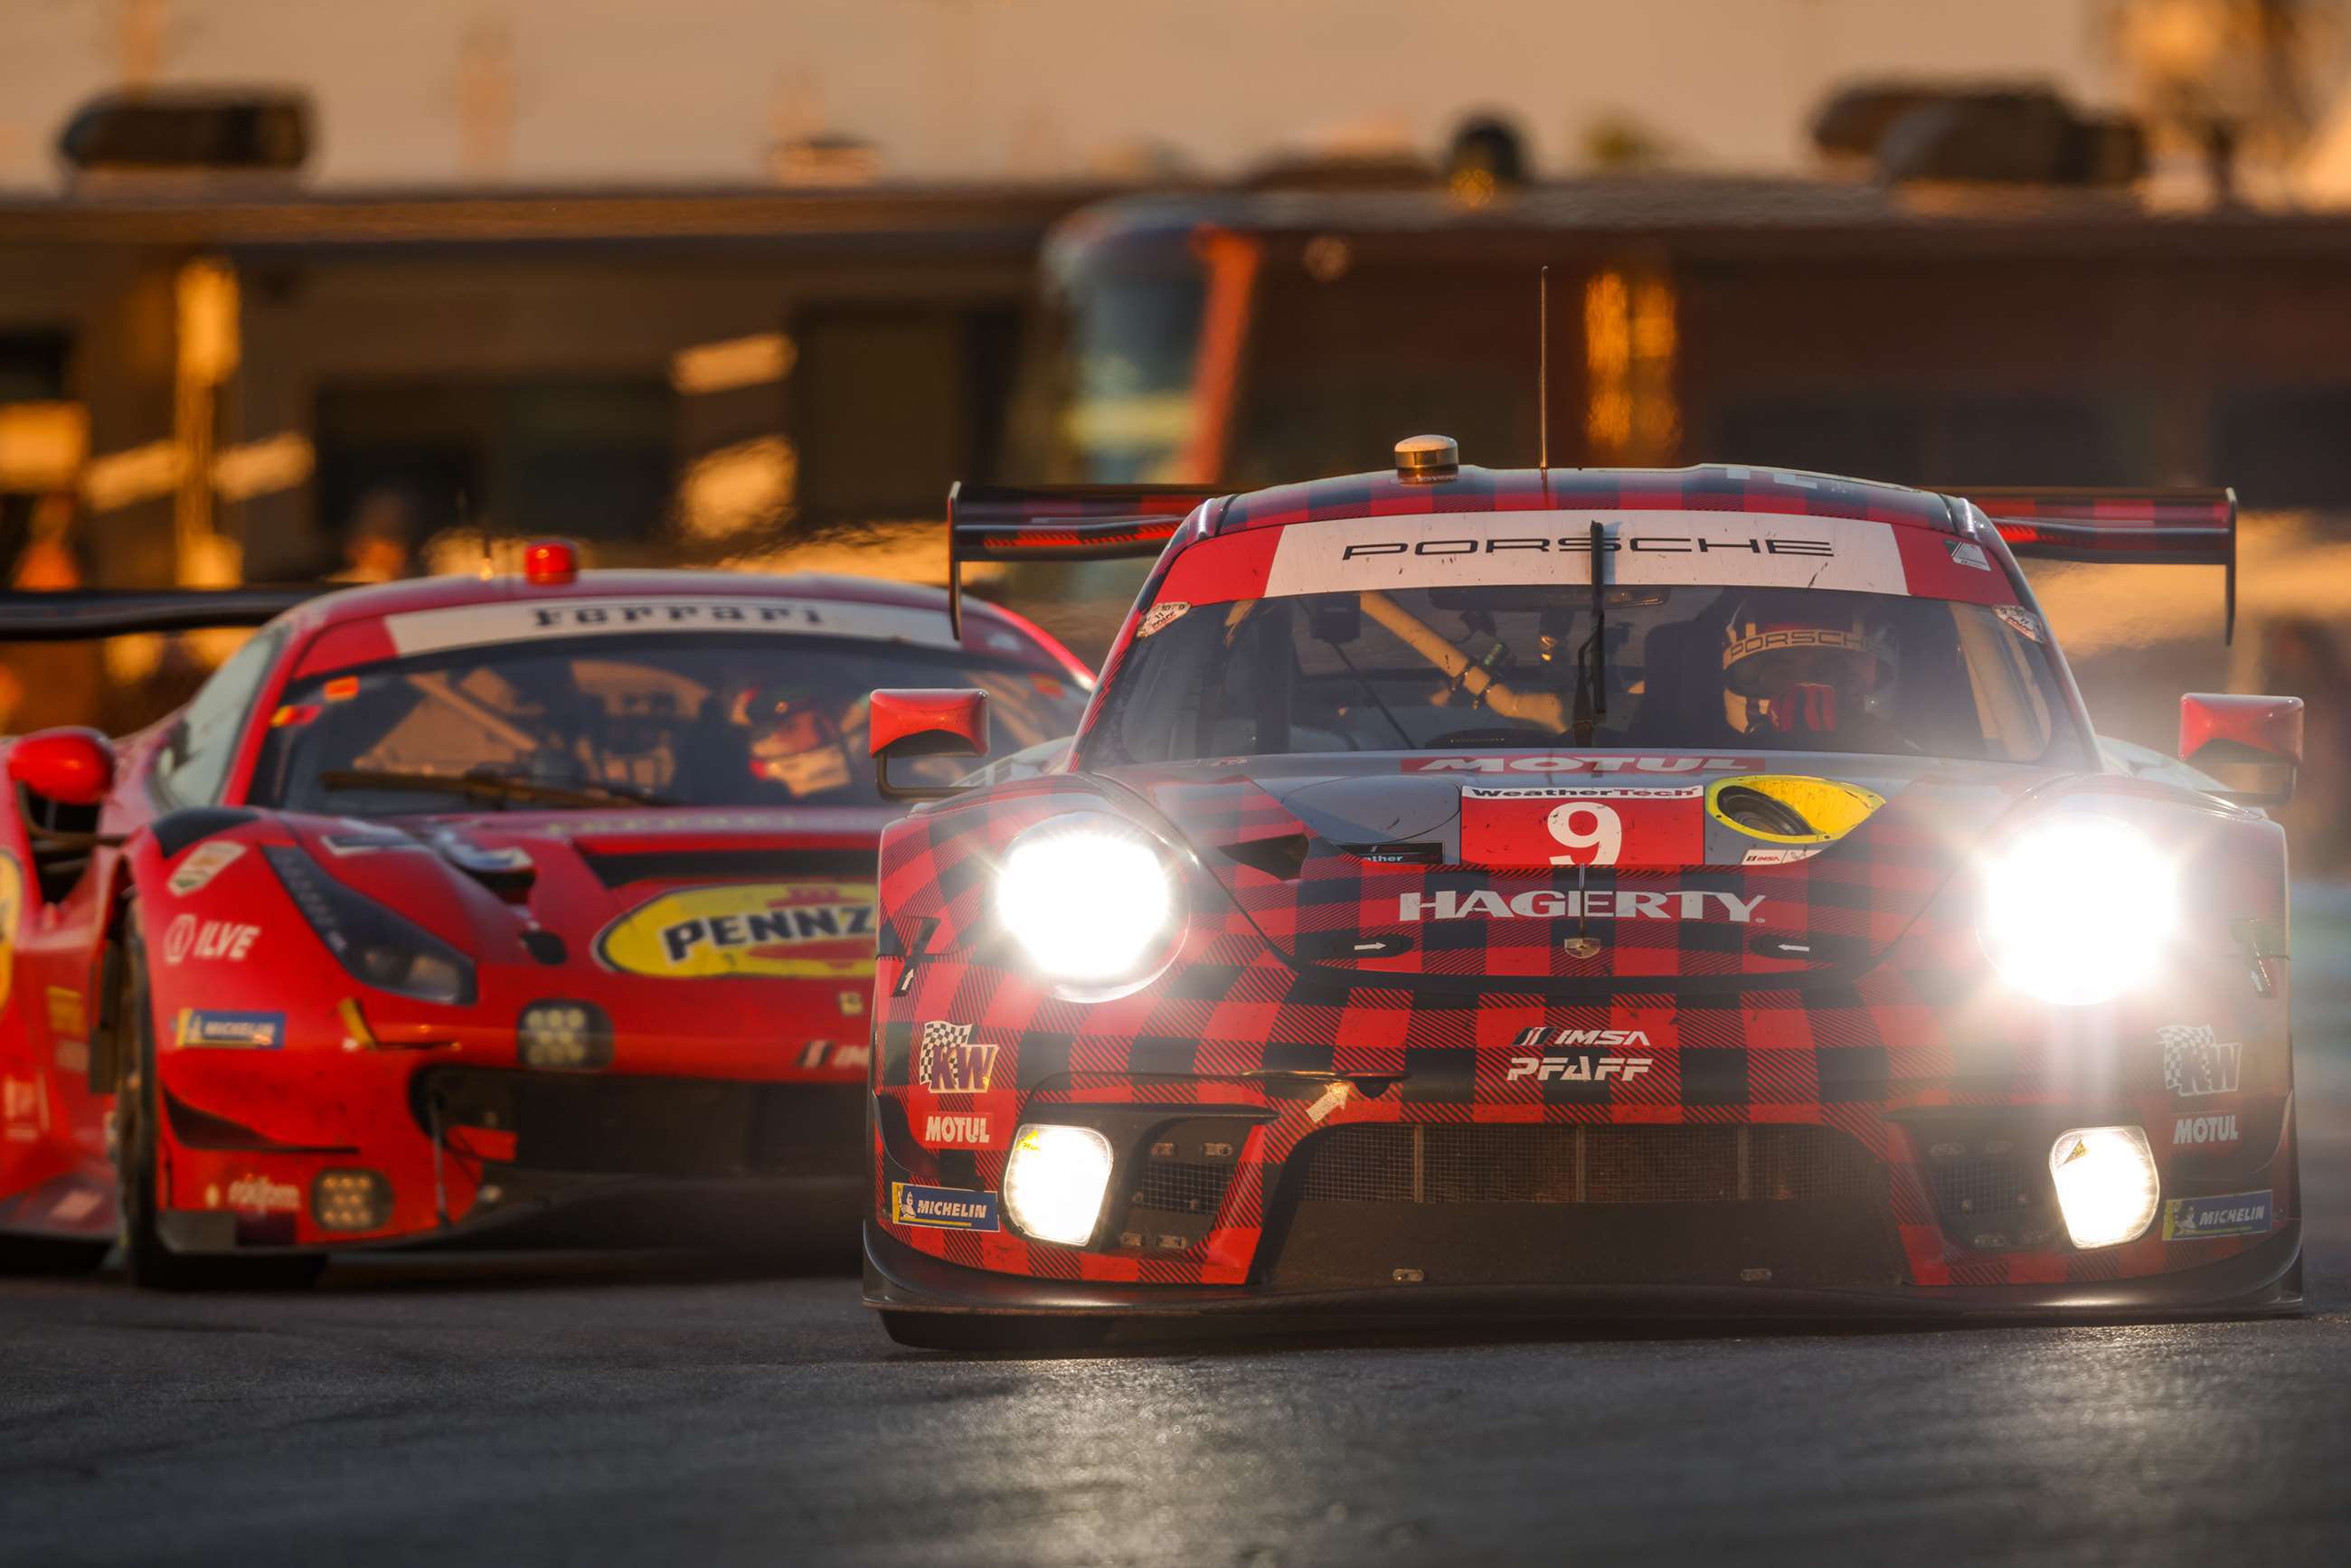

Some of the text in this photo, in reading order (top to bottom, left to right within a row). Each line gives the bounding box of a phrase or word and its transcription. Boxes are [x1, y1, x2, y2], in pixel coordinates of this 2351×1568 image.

[1342, 537, 1834, 561] PORSCHE
[1417, 757, 1750, 772] MOTUL
[1471, 788, 1697, 798] WeatherTech
[1547, 801, 1622, 865] 9
[1399, 890, 1766, 923] HAGERTY
[1554, 1030, 1651, 1047] IMSA
[930, 1044, 995, 1091] KW
[1506, 1055, 1654, 1082] PFAFF
[925, 1116, 990, 1144] MOTUL
[2173, 1115, 2239, 1145] MOTUL
[917, 1199, 987, 1219] MICHELIN
[2198, 1205, 2265, 1226] MICHELIN
